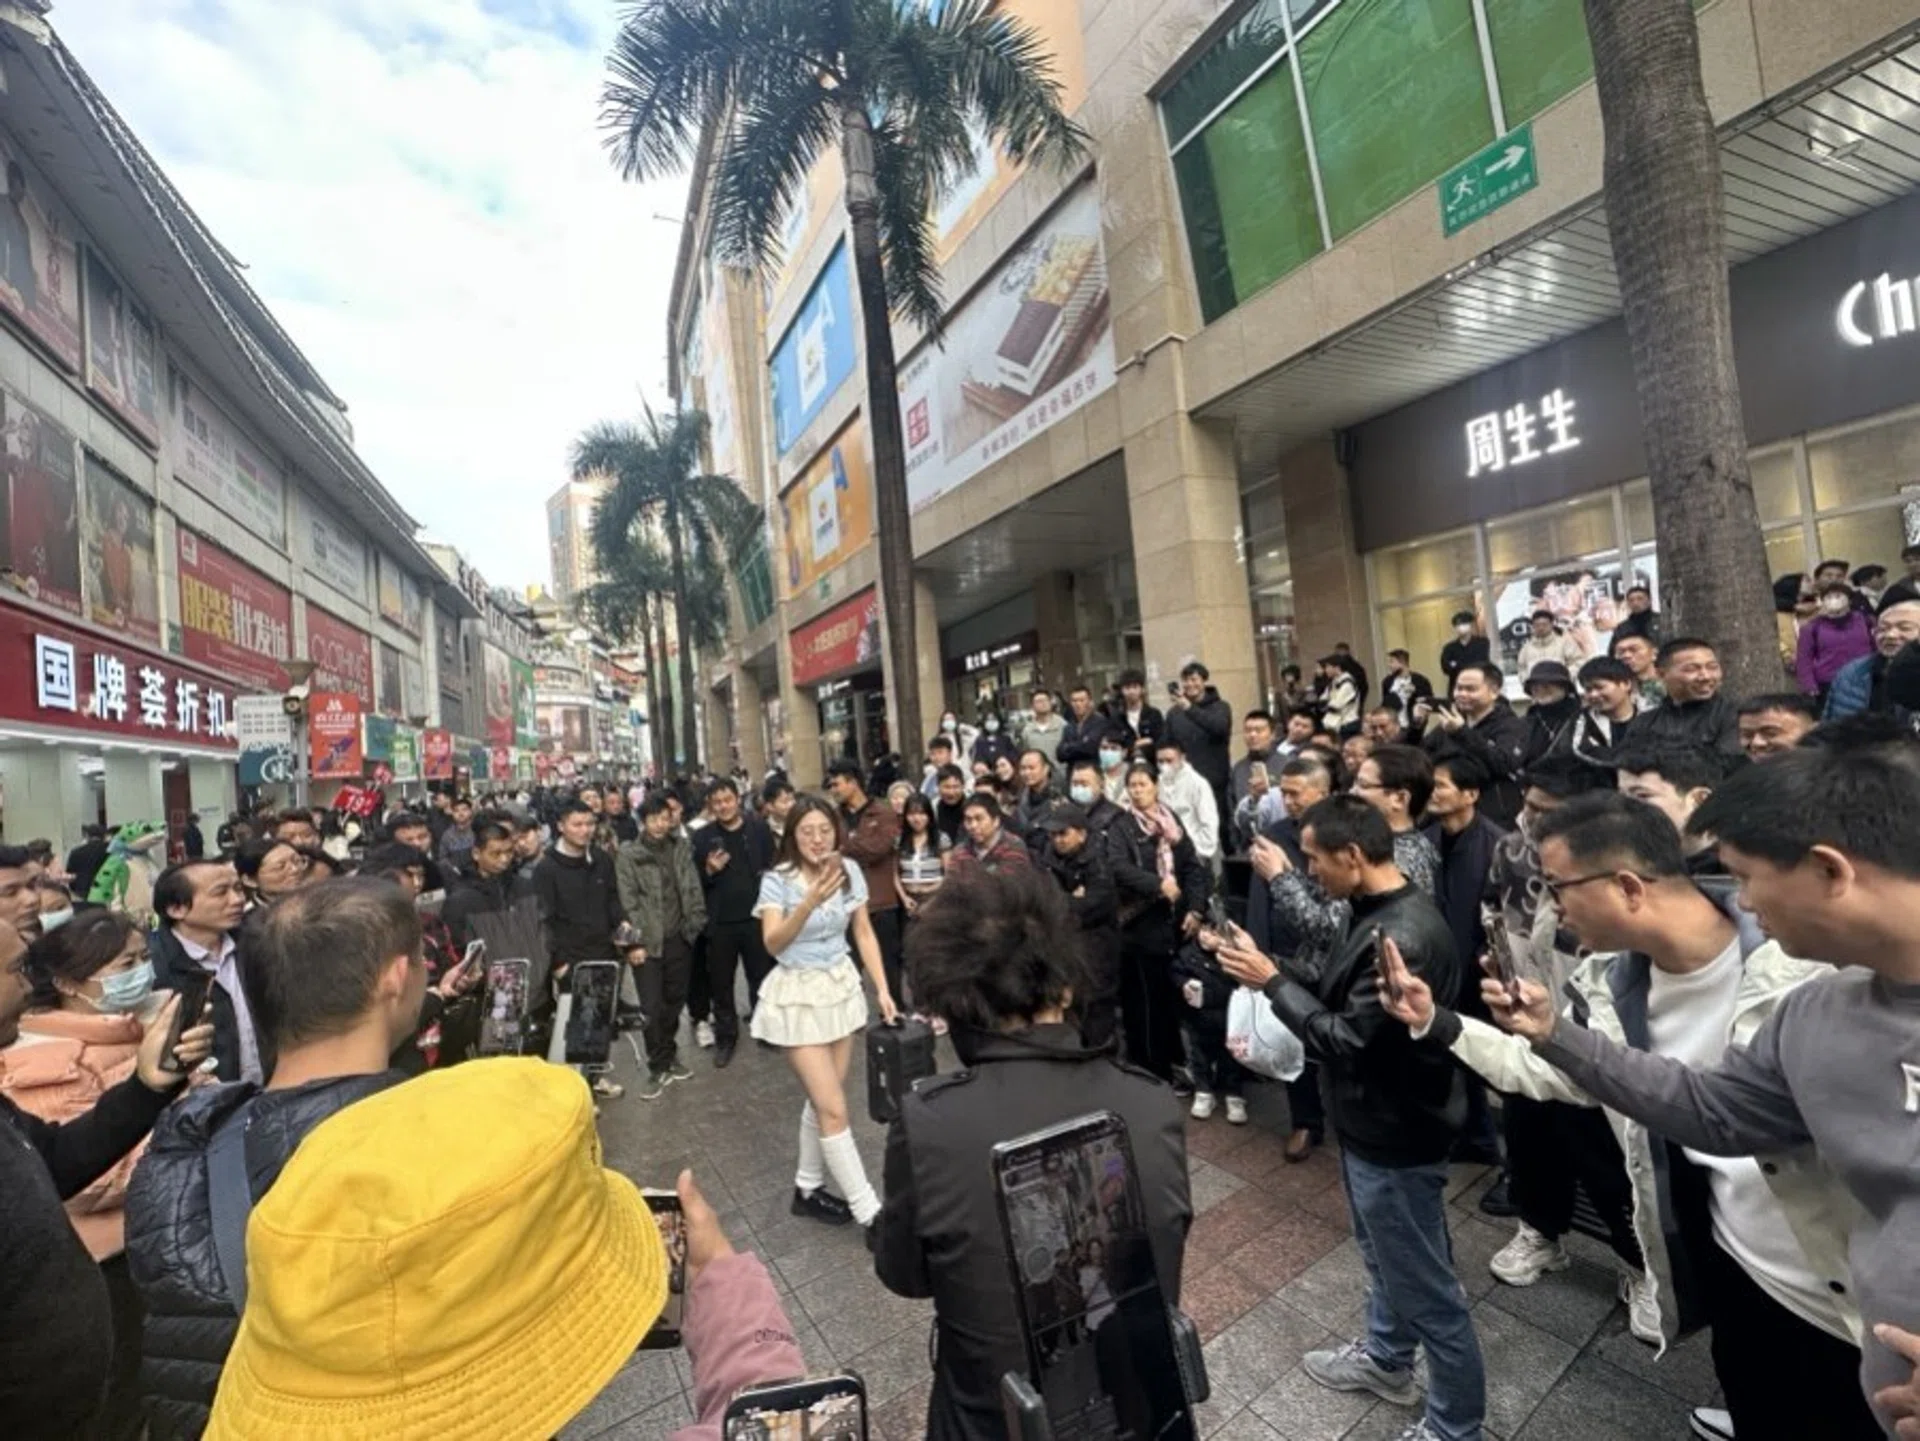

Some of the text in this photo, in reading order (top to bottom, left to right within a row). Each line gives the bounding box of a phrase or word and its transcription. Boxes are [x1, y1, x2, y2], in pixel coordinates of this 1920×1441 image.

[1836, 271, 1920, 346] Ch
[1465, 388, 1582, 478] 周生生
[35, 633, 238, 740] 国牌荟折扣
